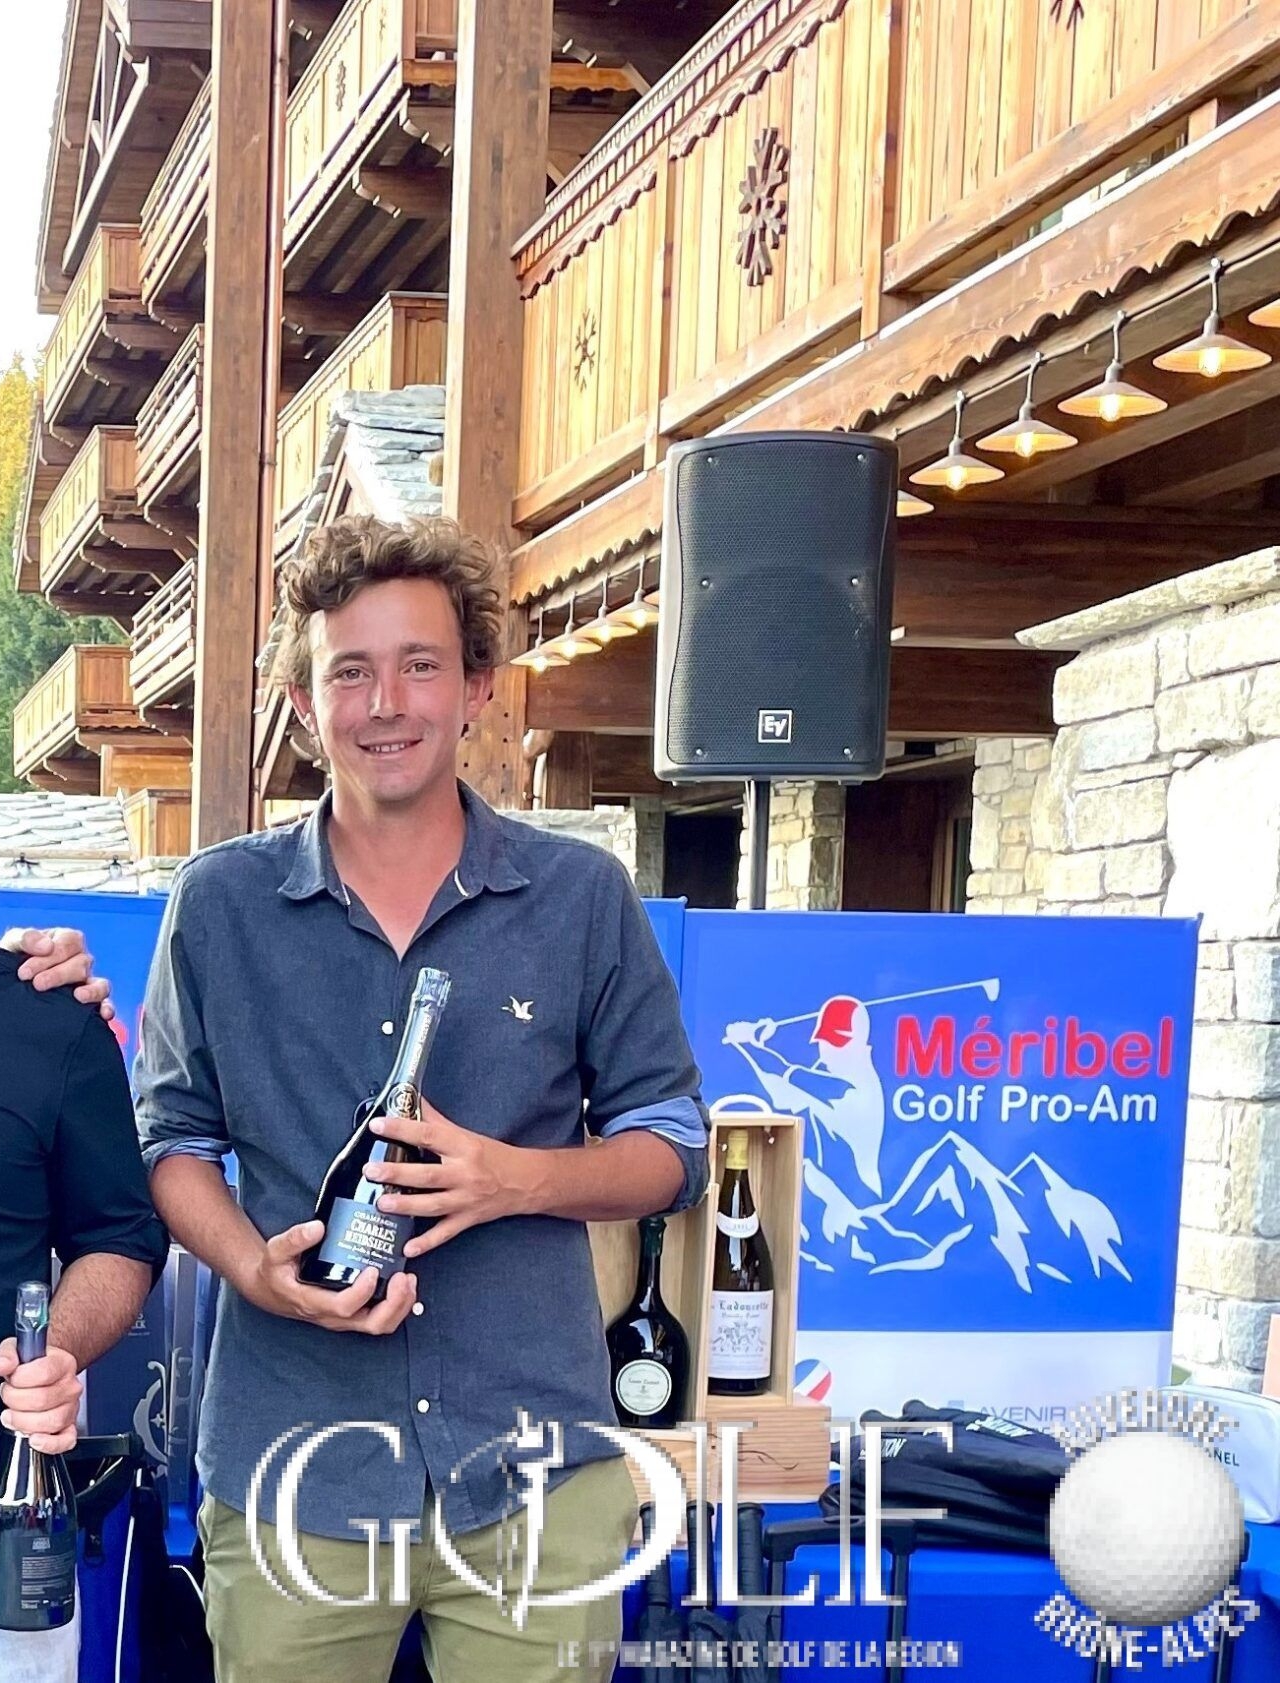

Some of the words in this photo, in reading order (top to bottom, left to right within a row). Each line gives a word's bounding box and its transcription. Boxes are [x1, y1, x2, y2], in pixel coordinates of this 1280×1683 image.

[895, 1015, 1174, 1078] Méribel
[892, 1084, 985, 1122] Golf
[1001, 1085, 1158, 1122] Pro-Am
[350, 1219, 397, 1242] CHARLES
